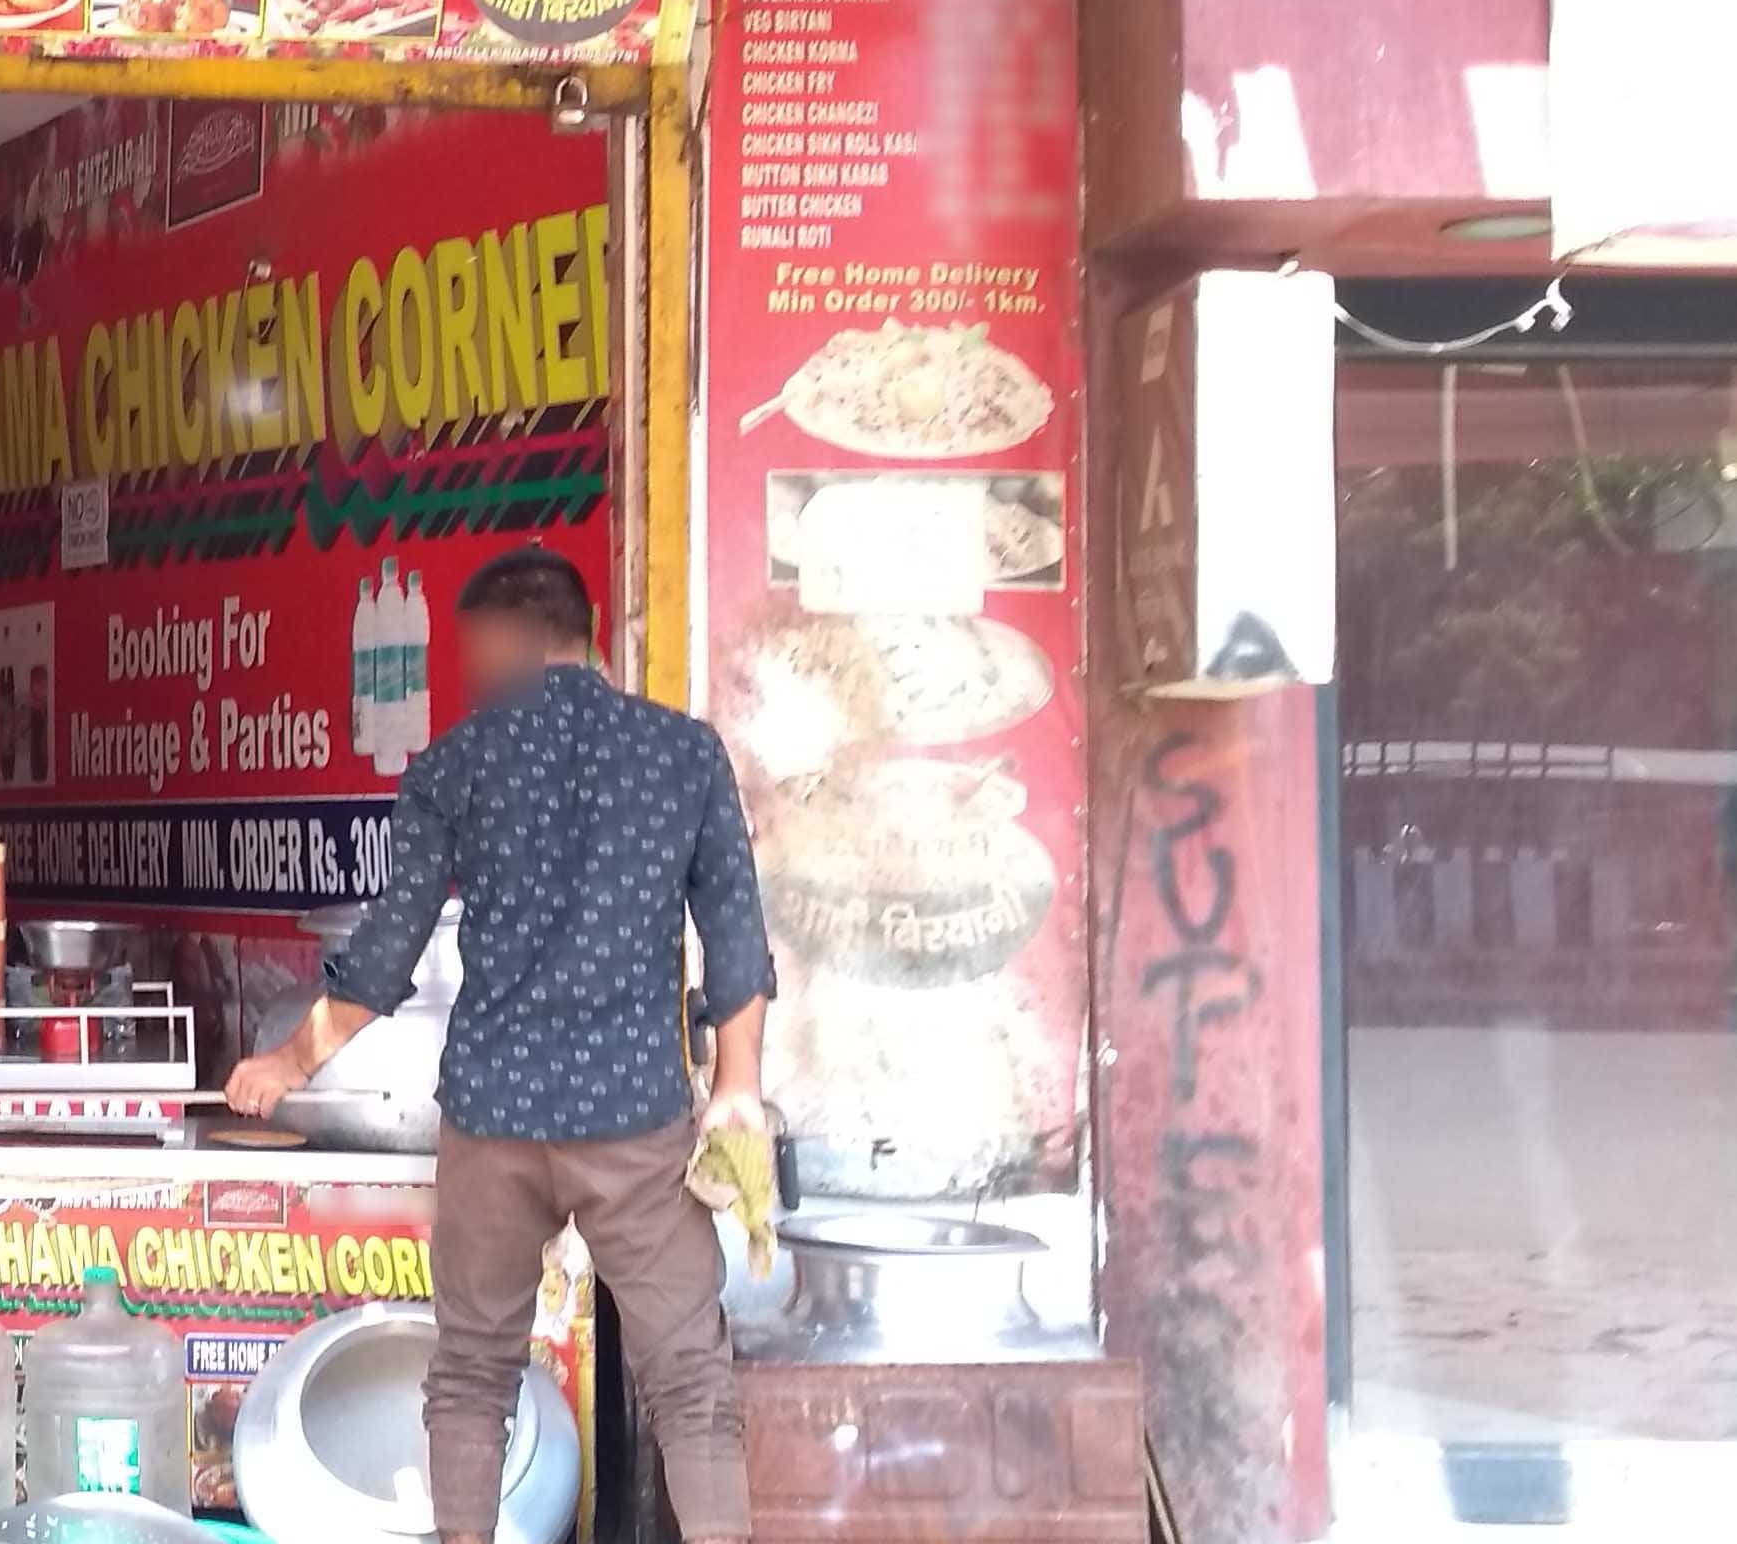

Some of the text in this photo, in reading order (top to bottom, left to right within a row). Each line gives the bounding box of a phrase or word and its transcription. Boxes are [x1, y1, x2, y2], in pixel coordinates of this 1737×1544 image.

[743, 9, 832, 33] VEG BIRYANI
[742, 40, 858, 65] CHICKEN KORMA
[742, 71, 836, 95] CHICKEN FRY
[742, 102, 805, 126] CHICKEN
[742, 132, 805, 156] CHICKEN
[844, 132, 881, 156] ROLL
[741, 163, 801, 187] MUTTON
[741, 194, 862, 218] BUTTER CHICKEN
[741, 225, 832, 249] RUMALI ROTI
[775, 262, 1040, 290] Free Home Delivery
[767, 290, 815, 313] Min
[824, 290, 901, 313] Order
[909, 291, 974, 313] 300/-
[75, 272, 326, 478] CHICKEN
[108, 596, 272, 691] Booking For
[70, 693, 331, 793] Marriage & Parties
[36, 822, 83, 885] HOME
[87, 821, 171, 887] DELIVERY
[182, 819, 225, 890] MIN.
[229, 818, 304, 892] ORDER
[308, 818, 346, 895] Rs.
[350, 816, 392, 896] 300
[131, 1225, 327, 1294] CHICKEN
[192, 1342, 226, 1371] FREE
[228, 1342, 265, 1372] HOME
